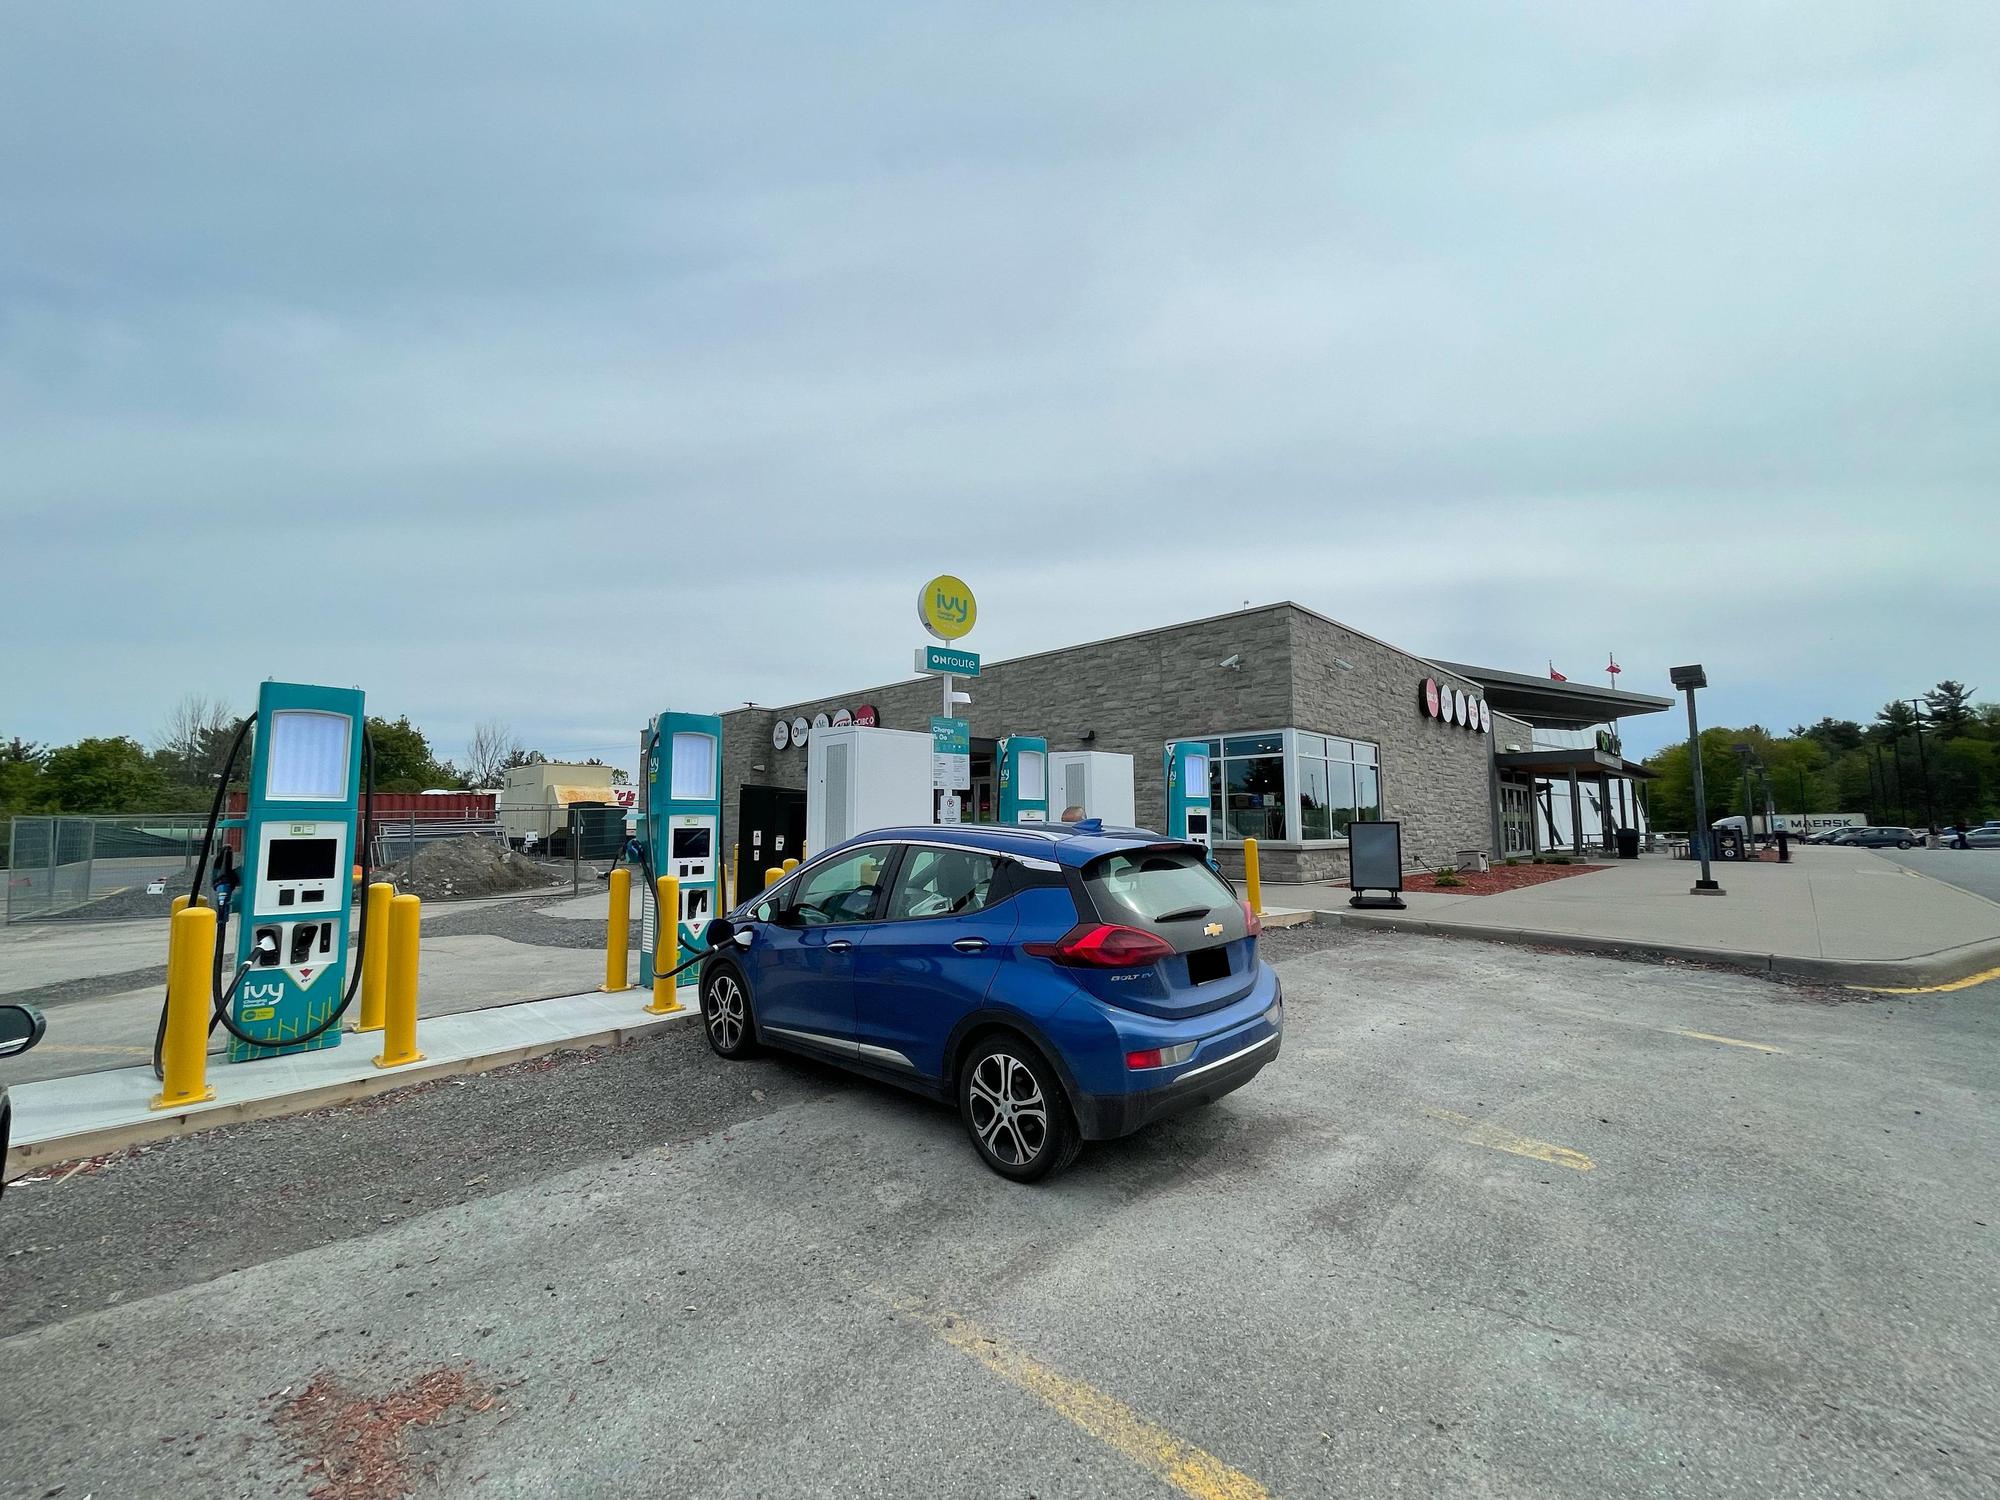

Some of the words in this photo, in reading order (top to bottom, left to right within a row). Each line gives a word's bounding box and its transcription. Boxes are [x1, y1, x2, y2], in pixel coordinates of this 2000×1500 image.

[937, 588, 967, 623] ivy
[933, 726, 954, 735] Charge
[650, 757, 659, 773] vy
[1792, 819, 1852, 828] MAERSK
[243, 981, 284, 1005] ivy
